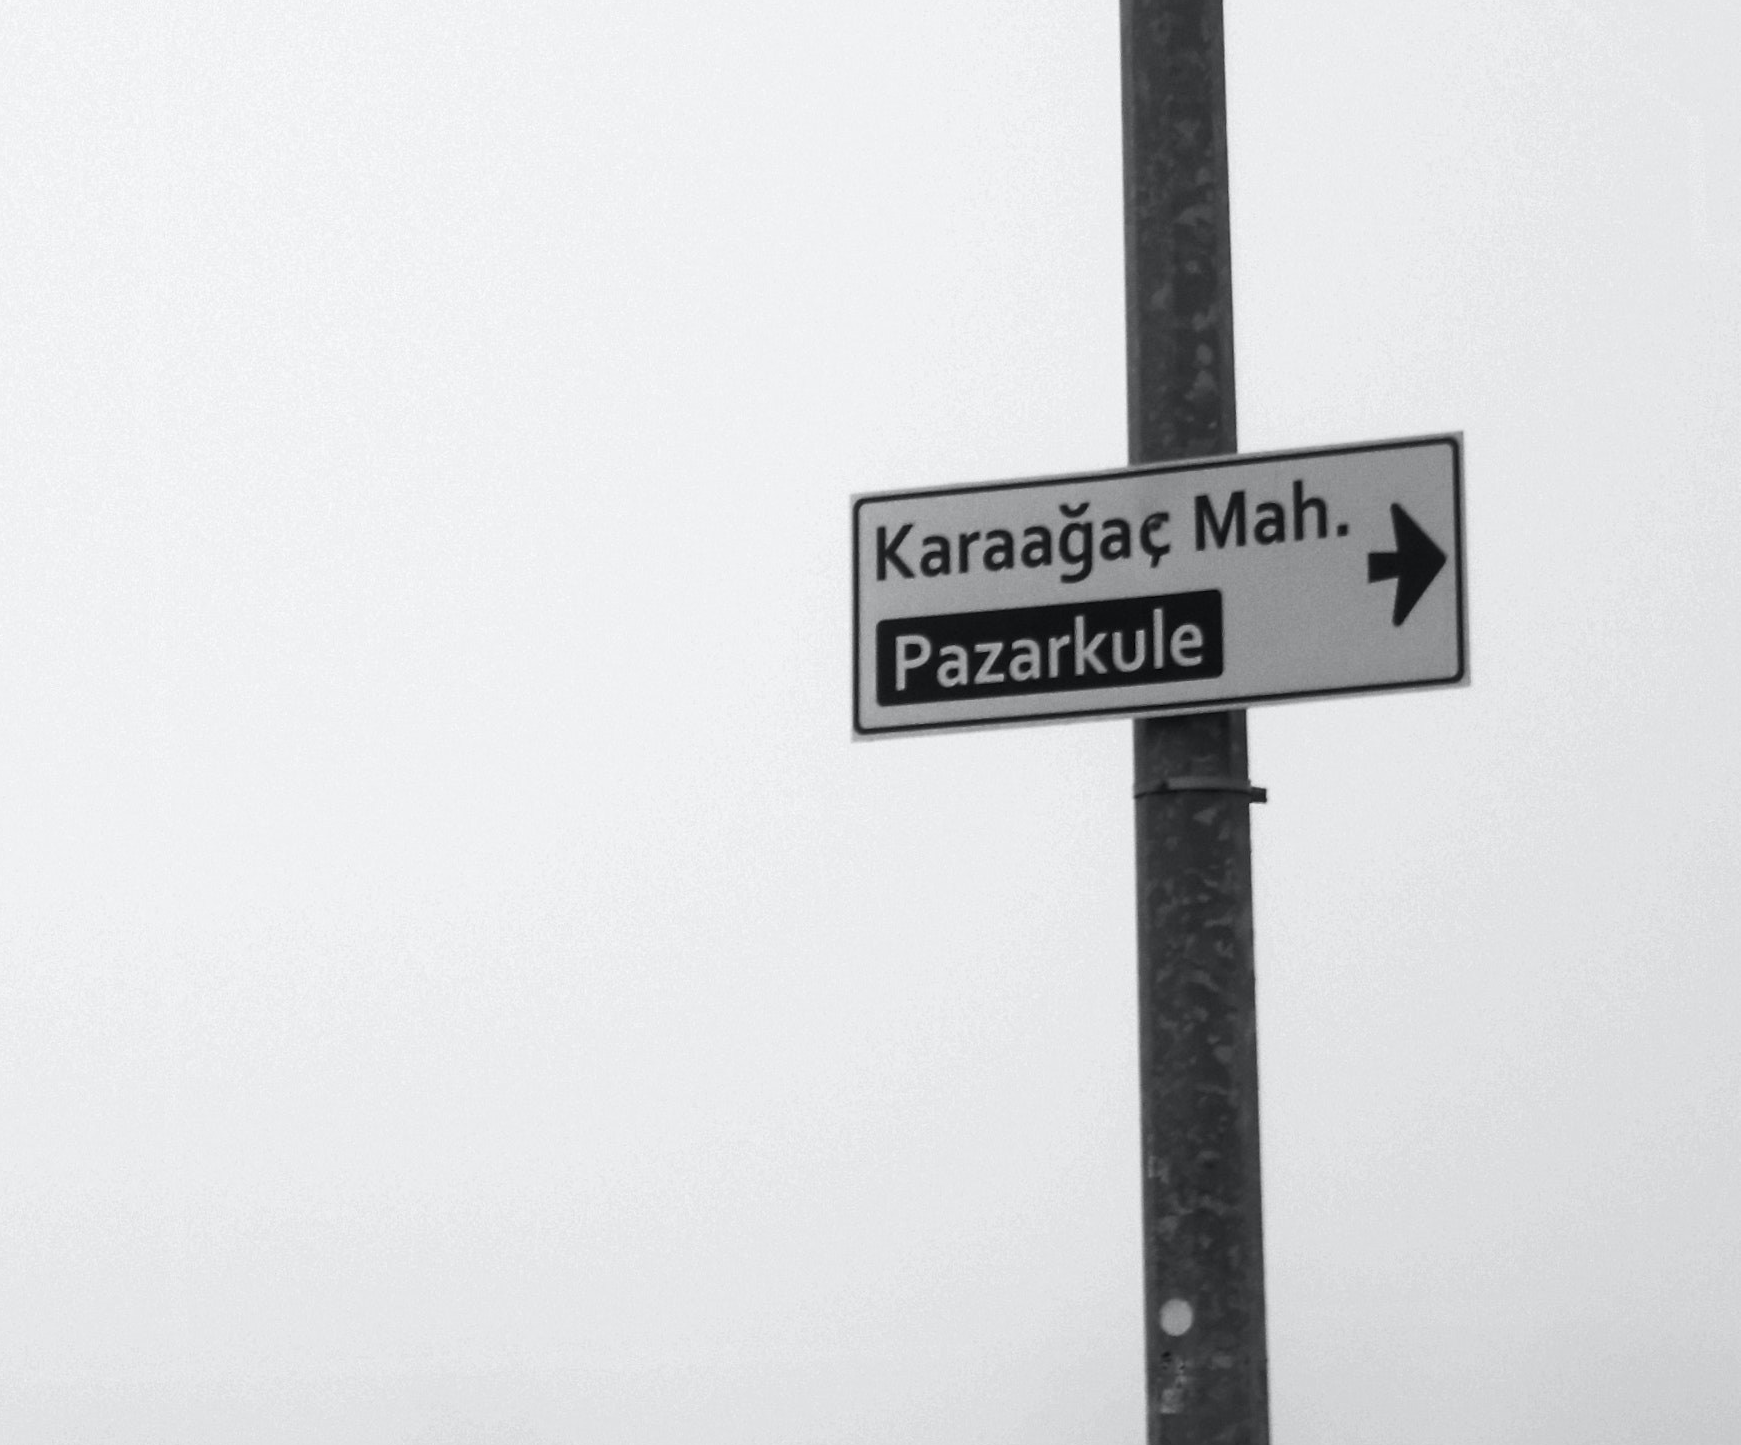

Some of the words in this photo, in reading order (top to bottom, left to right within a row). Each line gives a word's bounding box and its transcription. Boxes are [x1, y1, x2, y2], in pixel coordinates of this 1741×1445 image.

[875, 501, 1172, 584] Karaağaç
[1194, 479, 1350, 552] Mah.
[894, 608, 1204, 691] Pazarkule
